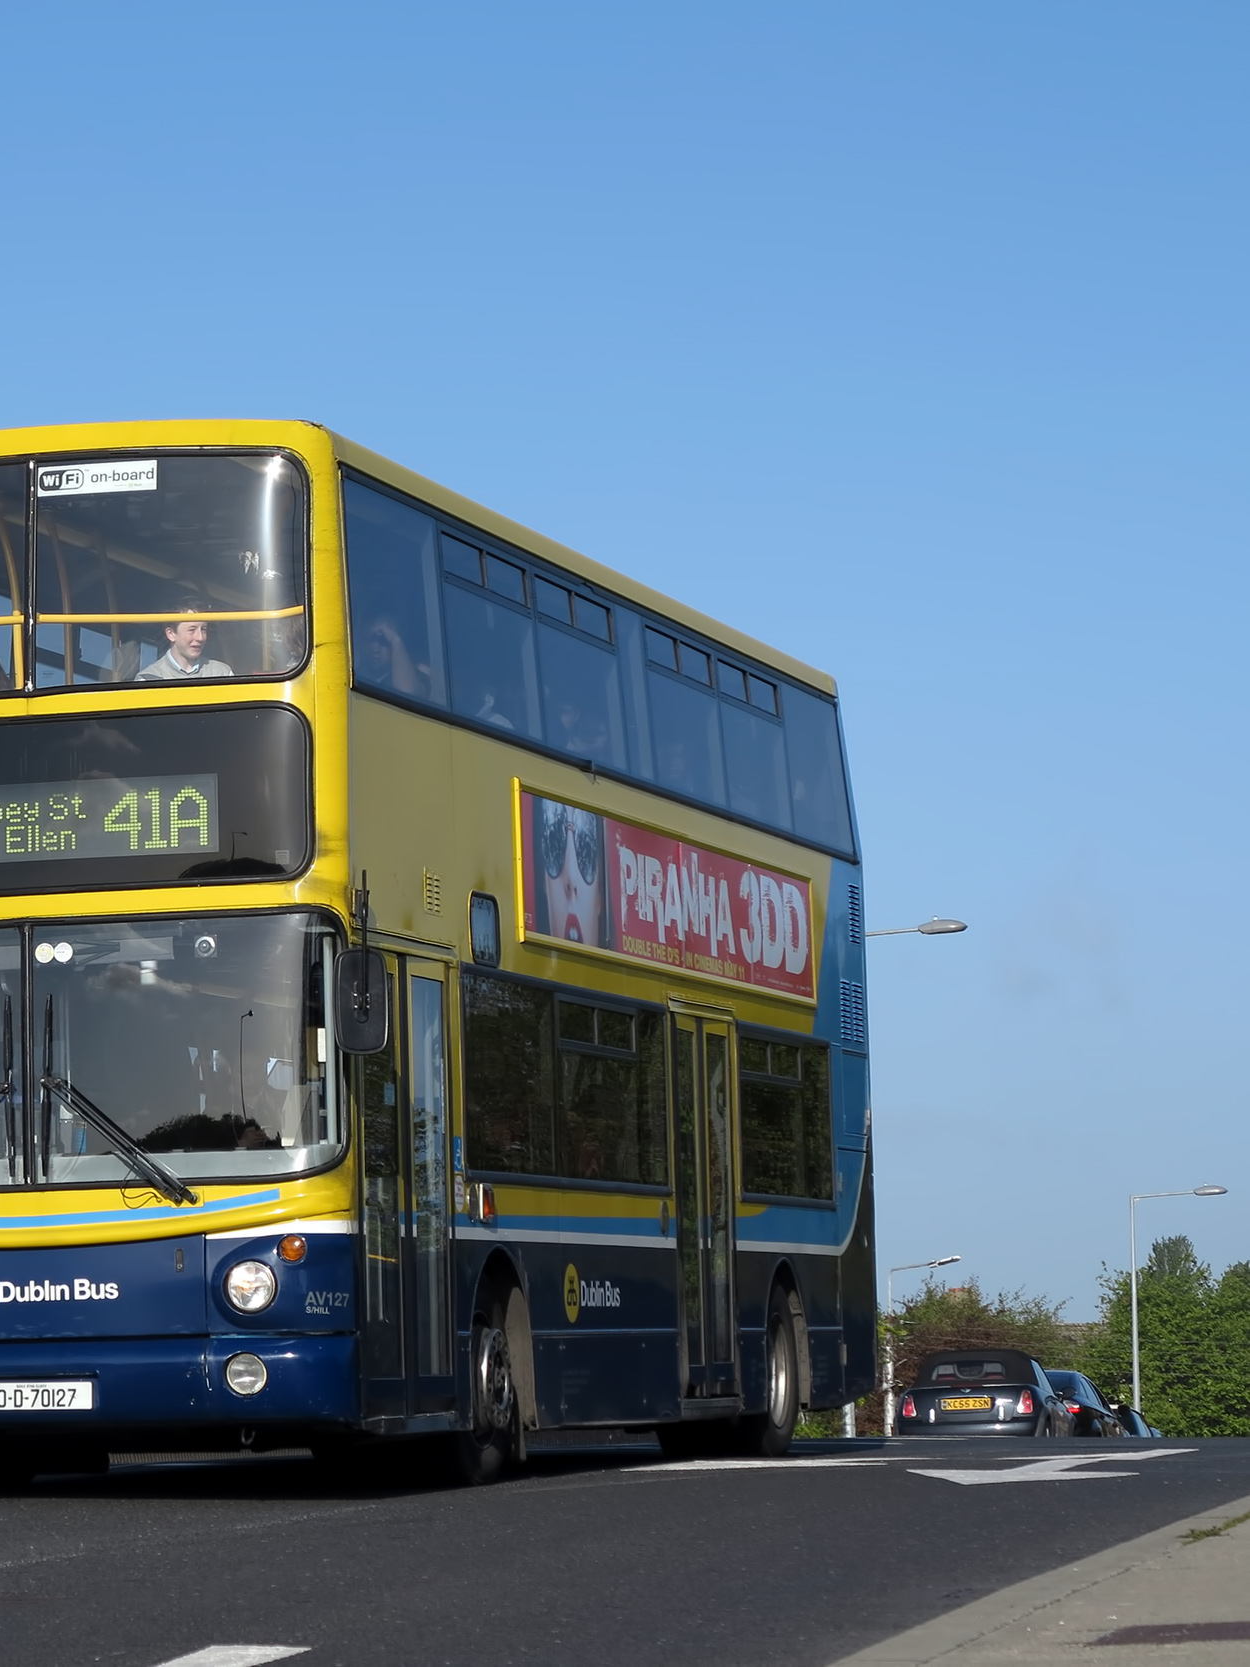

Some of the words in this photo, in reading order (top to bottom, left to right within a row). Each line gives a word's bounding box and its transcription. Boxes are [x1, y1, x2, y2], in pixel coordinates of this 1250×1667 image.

[91, 467, 154, 483] on-board
[49, 793, 86, 821] St
[104, 785, 208, 850] 41A
[6, 824, 76, 854] Ellen
[619, 847, 736, 957] PIRANHA
[739, 870, 809, 975] 3DD
[622, 935, 652, 957] DOUBLE
[652, 943, 667, 961] THE
[685, 952, 695, 967] IN
[695, 953, 723, 974] CINEMAS
[724, 961, 738, 977] MAY
[738, 966, 745, 980] 11
[73, 1278, 119, 1301] Bus
[305, 1291, 350, 1307] AV127
[580, 1280, 605, 1307] Dublin
[605, 1281, 620, 1307] Bus
